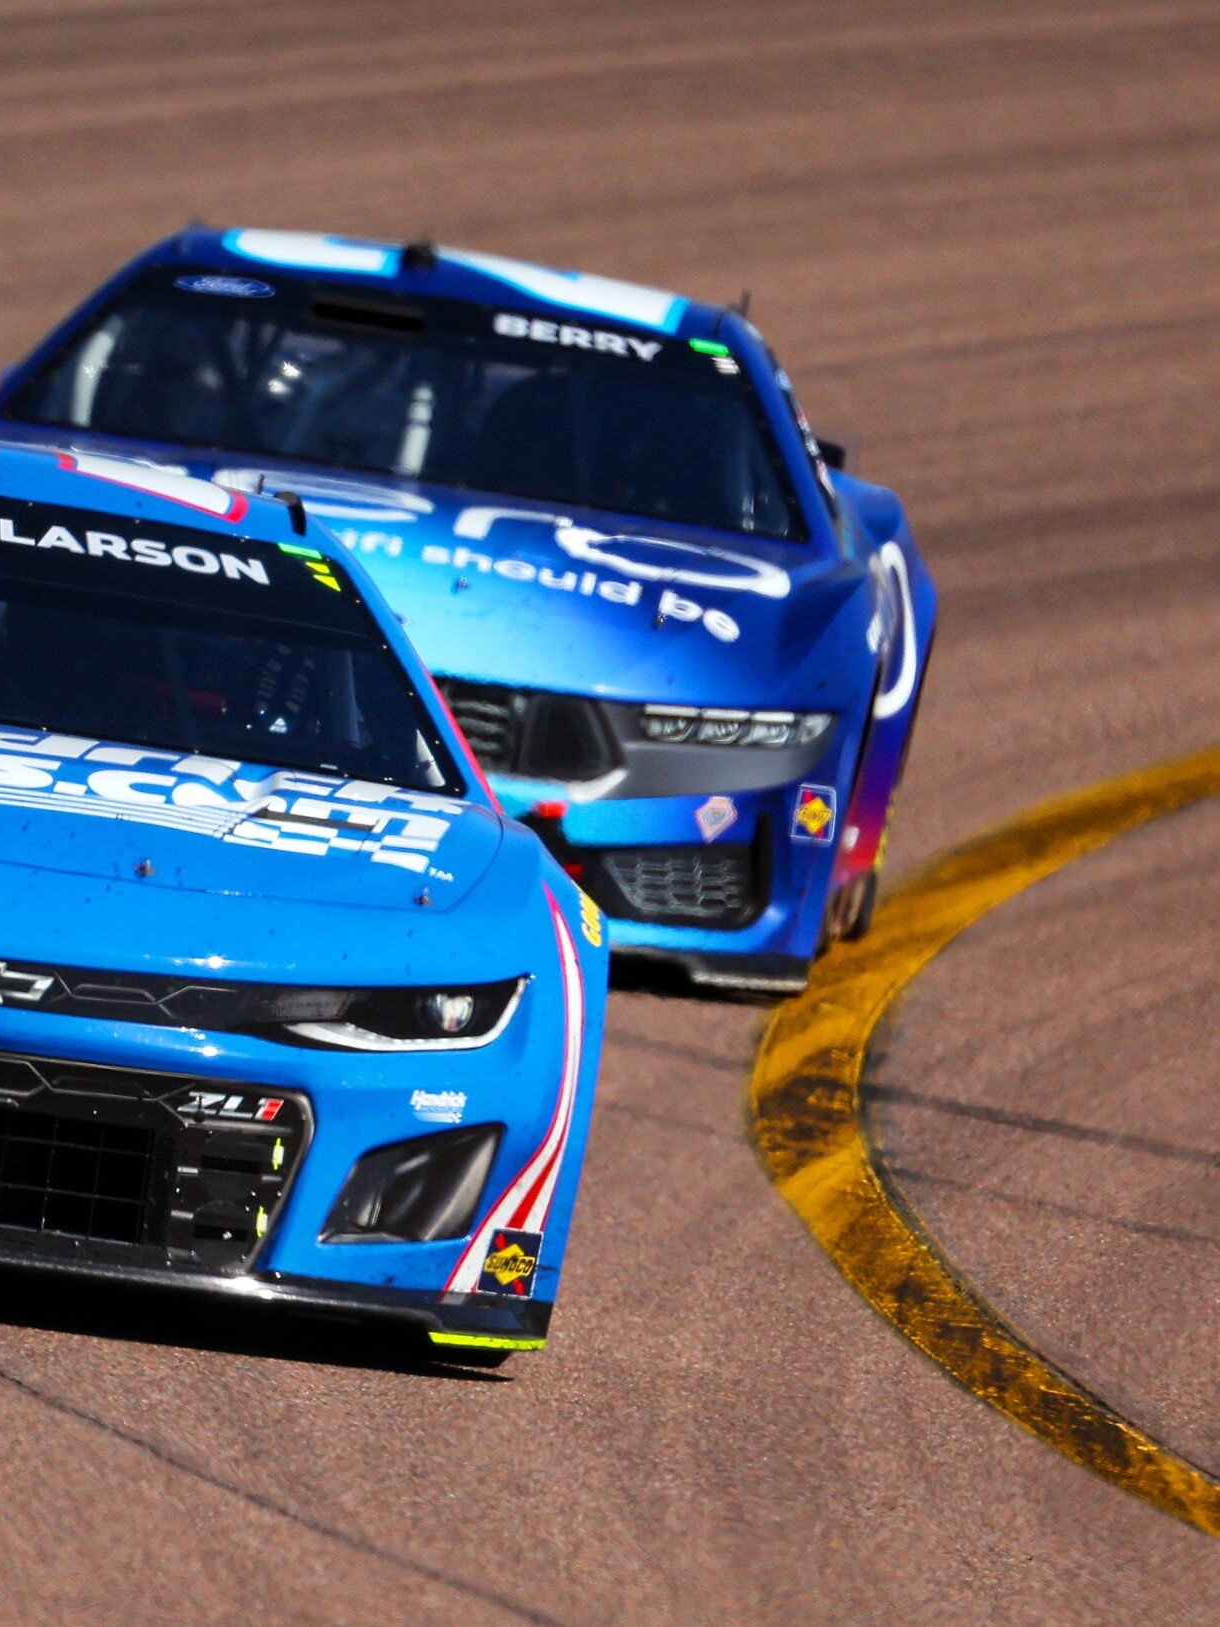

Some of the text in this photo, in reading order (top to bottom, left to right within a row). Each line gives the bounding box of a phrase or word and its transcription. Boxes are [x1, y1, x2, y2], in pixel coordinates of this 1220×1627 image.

[493, 313, 663, 362] BERRY
[331, 528, 741, 643] ifi should be
[177, 1091, 284, 1121] ZL1
[486, 1253, 536, 1275] SUNOCO
